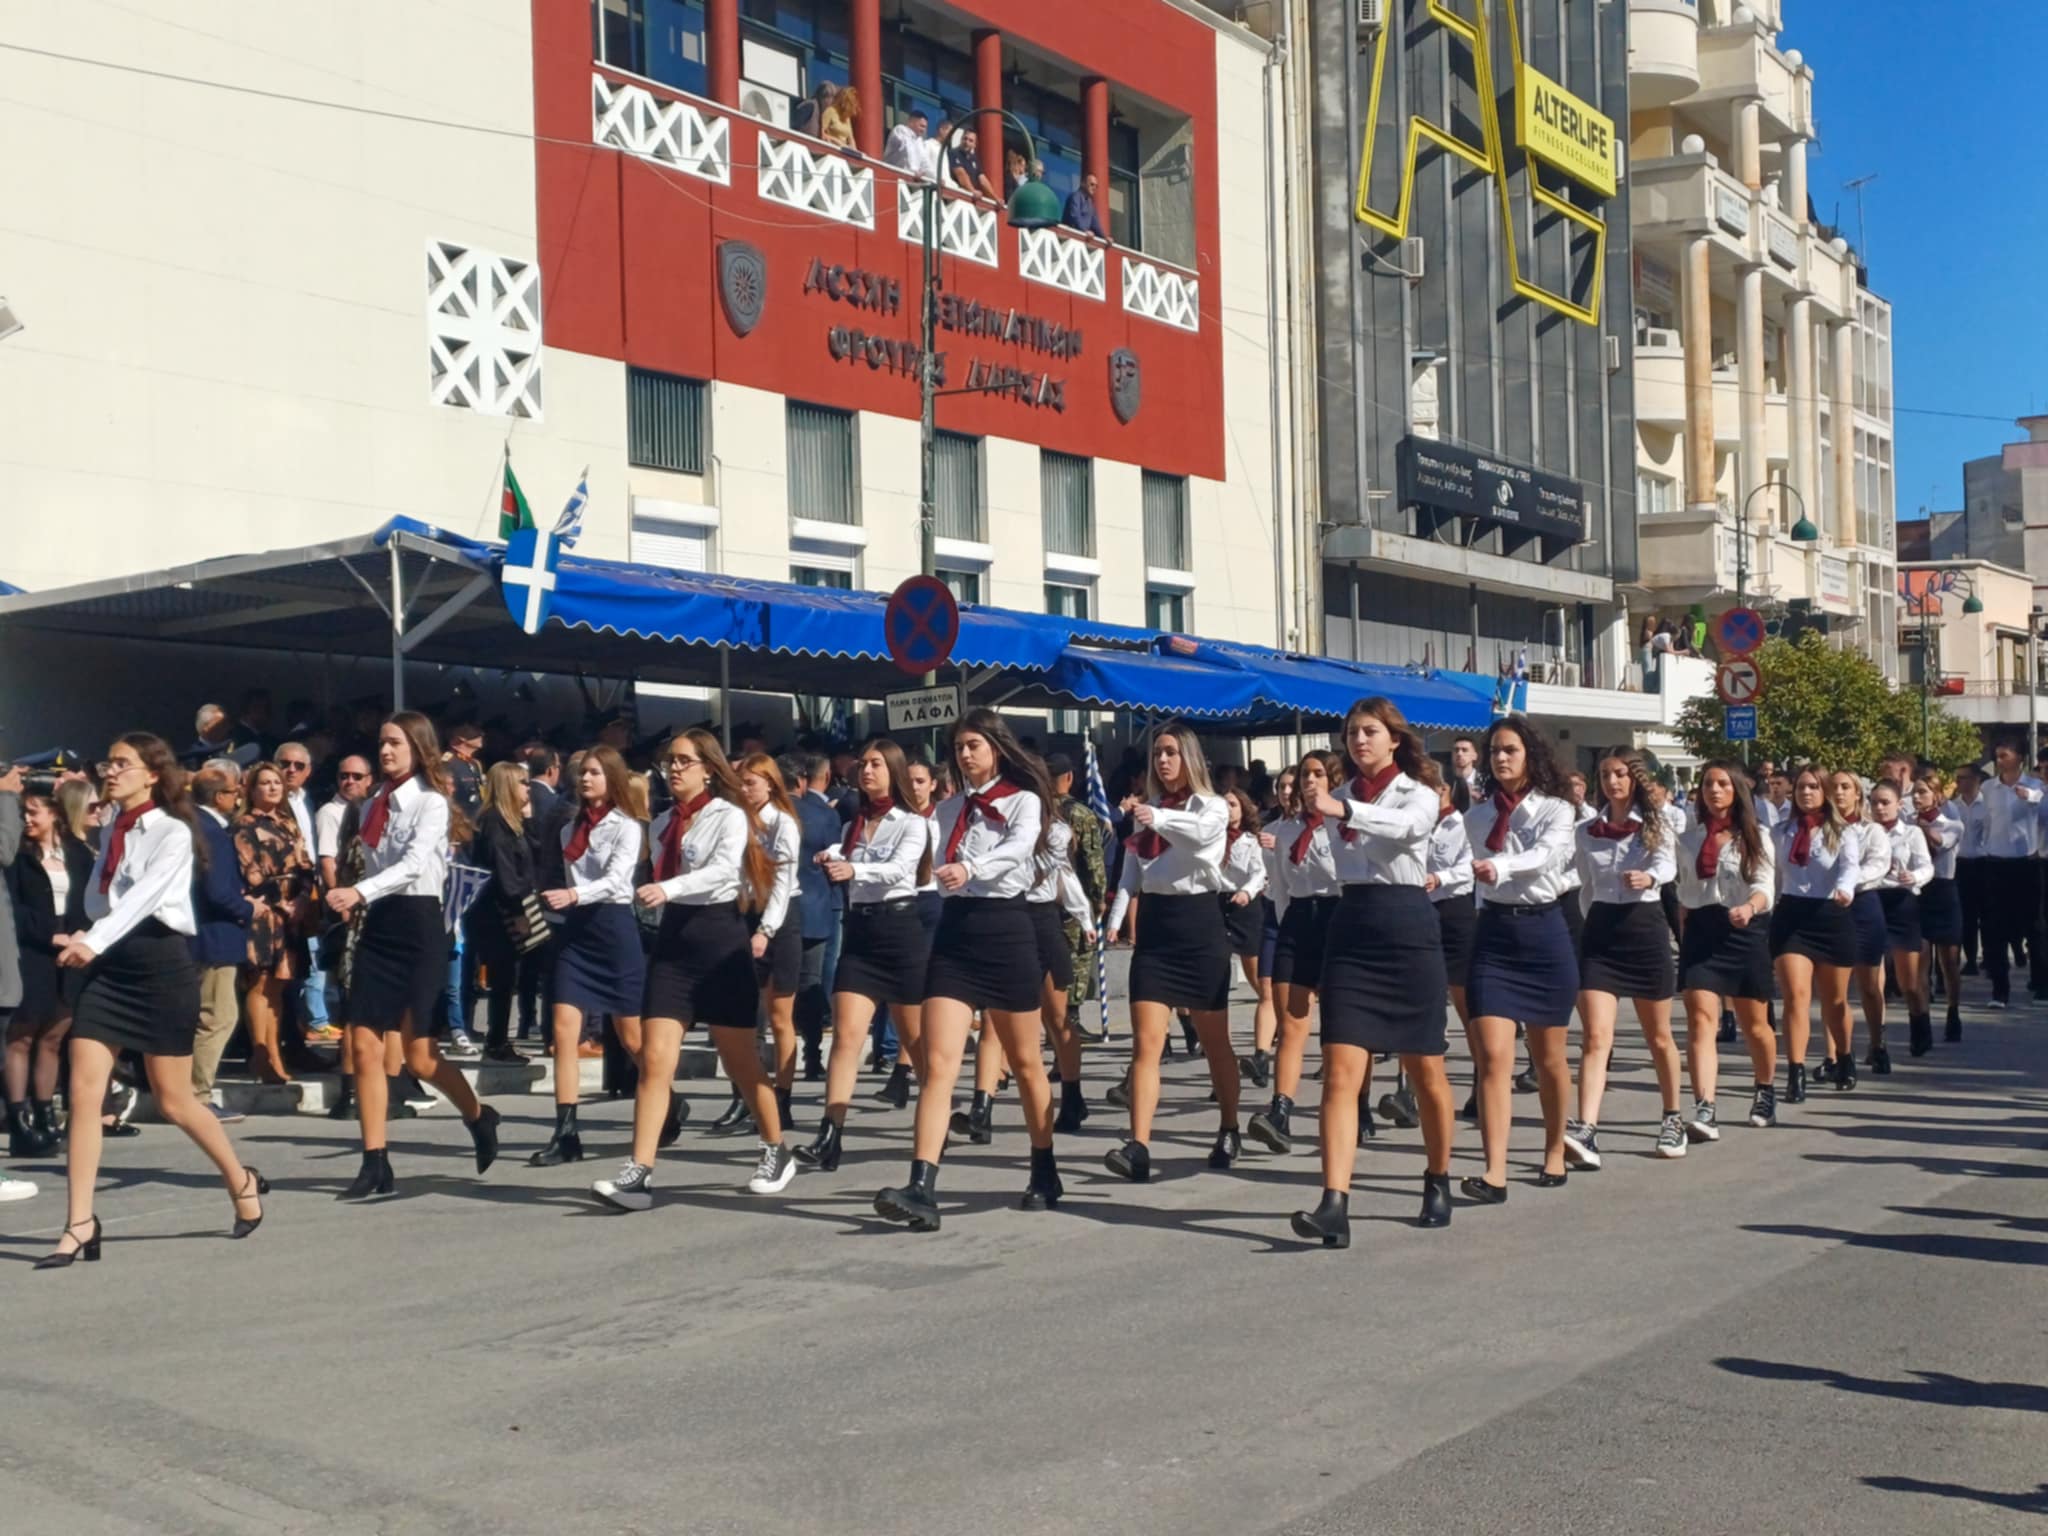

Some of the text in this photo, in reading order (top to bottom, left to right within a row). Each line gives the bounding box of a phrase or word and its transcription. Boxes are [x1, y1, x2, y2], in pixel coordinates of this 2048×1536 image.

[1533, 124, 1609, 180] FITNESS EXCELLENCE
[1534, 84, 1608, 160] ALTERLIFE
[932, 288, 1083, 361] ΞΙΩΜΑΤΙΚΩΝ
[903, 704, 955, 722] ΛΑΦΛ
